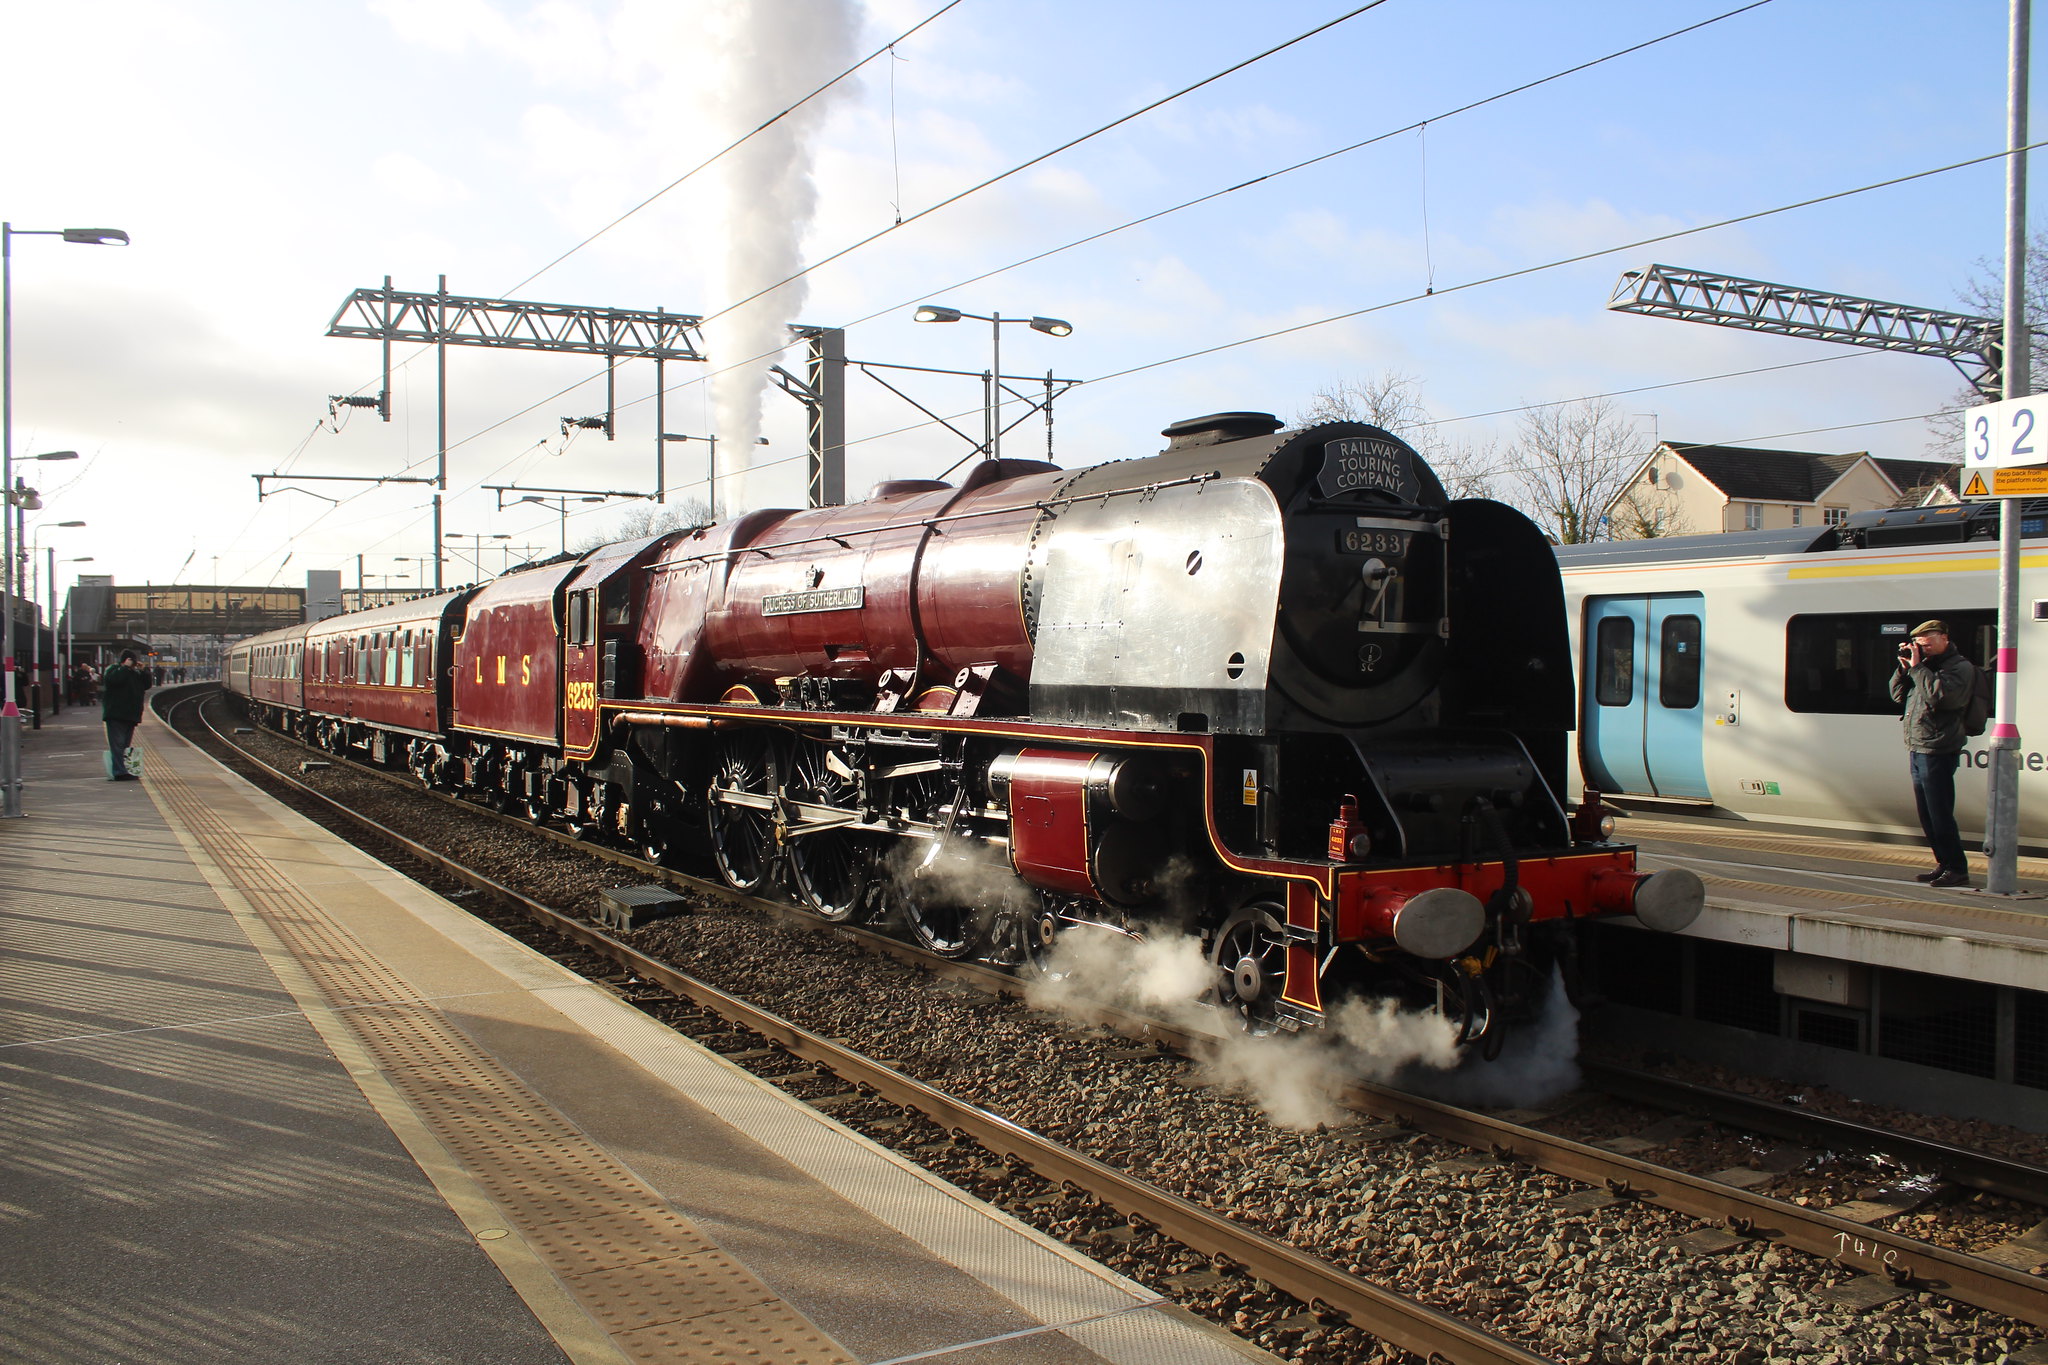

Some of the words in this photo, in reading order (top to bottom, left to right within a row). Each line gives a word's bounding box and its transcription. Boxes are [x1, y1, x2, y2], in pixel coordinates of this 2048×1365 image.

[1973, 415, 1989, 461] 3
[2010, 408, 2035, 456] 2
[1340, 441, 1399, 460] RAILWAY
[1338, 456, 1401, 477] TOURING
[1337, 471, 1404, 492] COMPANY
[1345, 531, 1401, 553] 6233
[765, 594, 796, 612] DUCHESS
[797, 594, 807, 609] OF
[809, 587, 858, 608] SUTHERLAND
[567, 681, 595, 710] 6233
[1854, 1238, 1898, 1265] 410
